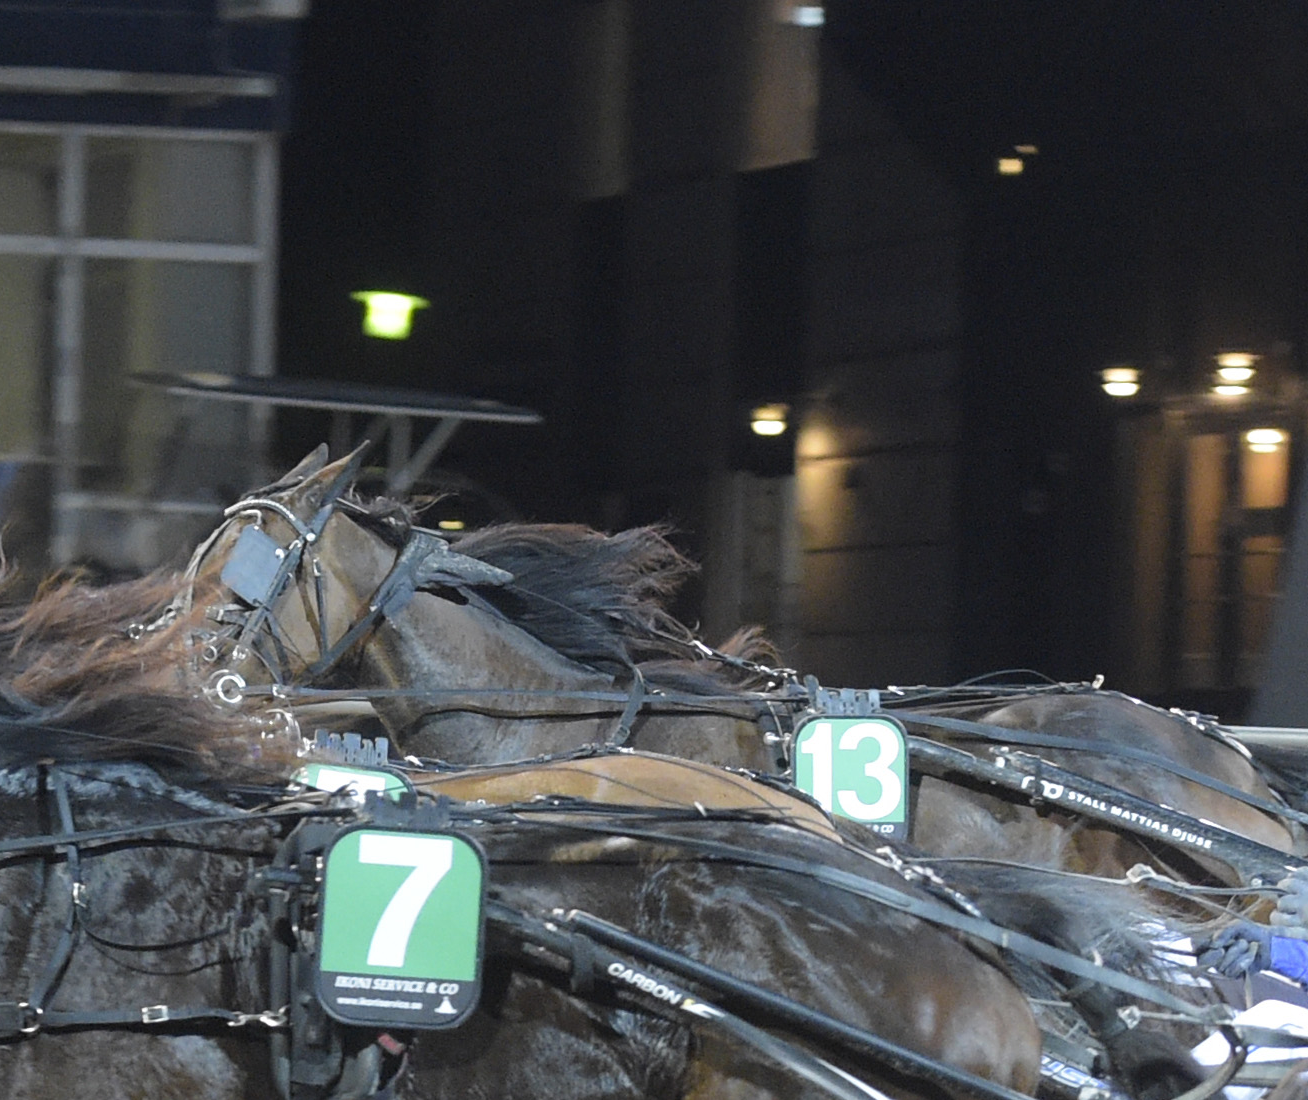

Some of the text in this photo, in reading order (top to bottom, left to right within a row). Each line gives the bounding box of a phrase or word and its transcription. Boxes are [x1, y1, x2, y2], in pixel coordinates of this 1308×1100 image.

[800, 722, 902, 820] 13
[1067, 790, 1213, 850] STALL MATTIAS DJUSE
[358, 833, 453, 968] 7
[372, 978, 426, 994] SERVICE
[426, 982, 438, 995] &
[438, 983, 460, 995] CO
[607, 962, 683, 1005] CARBON
